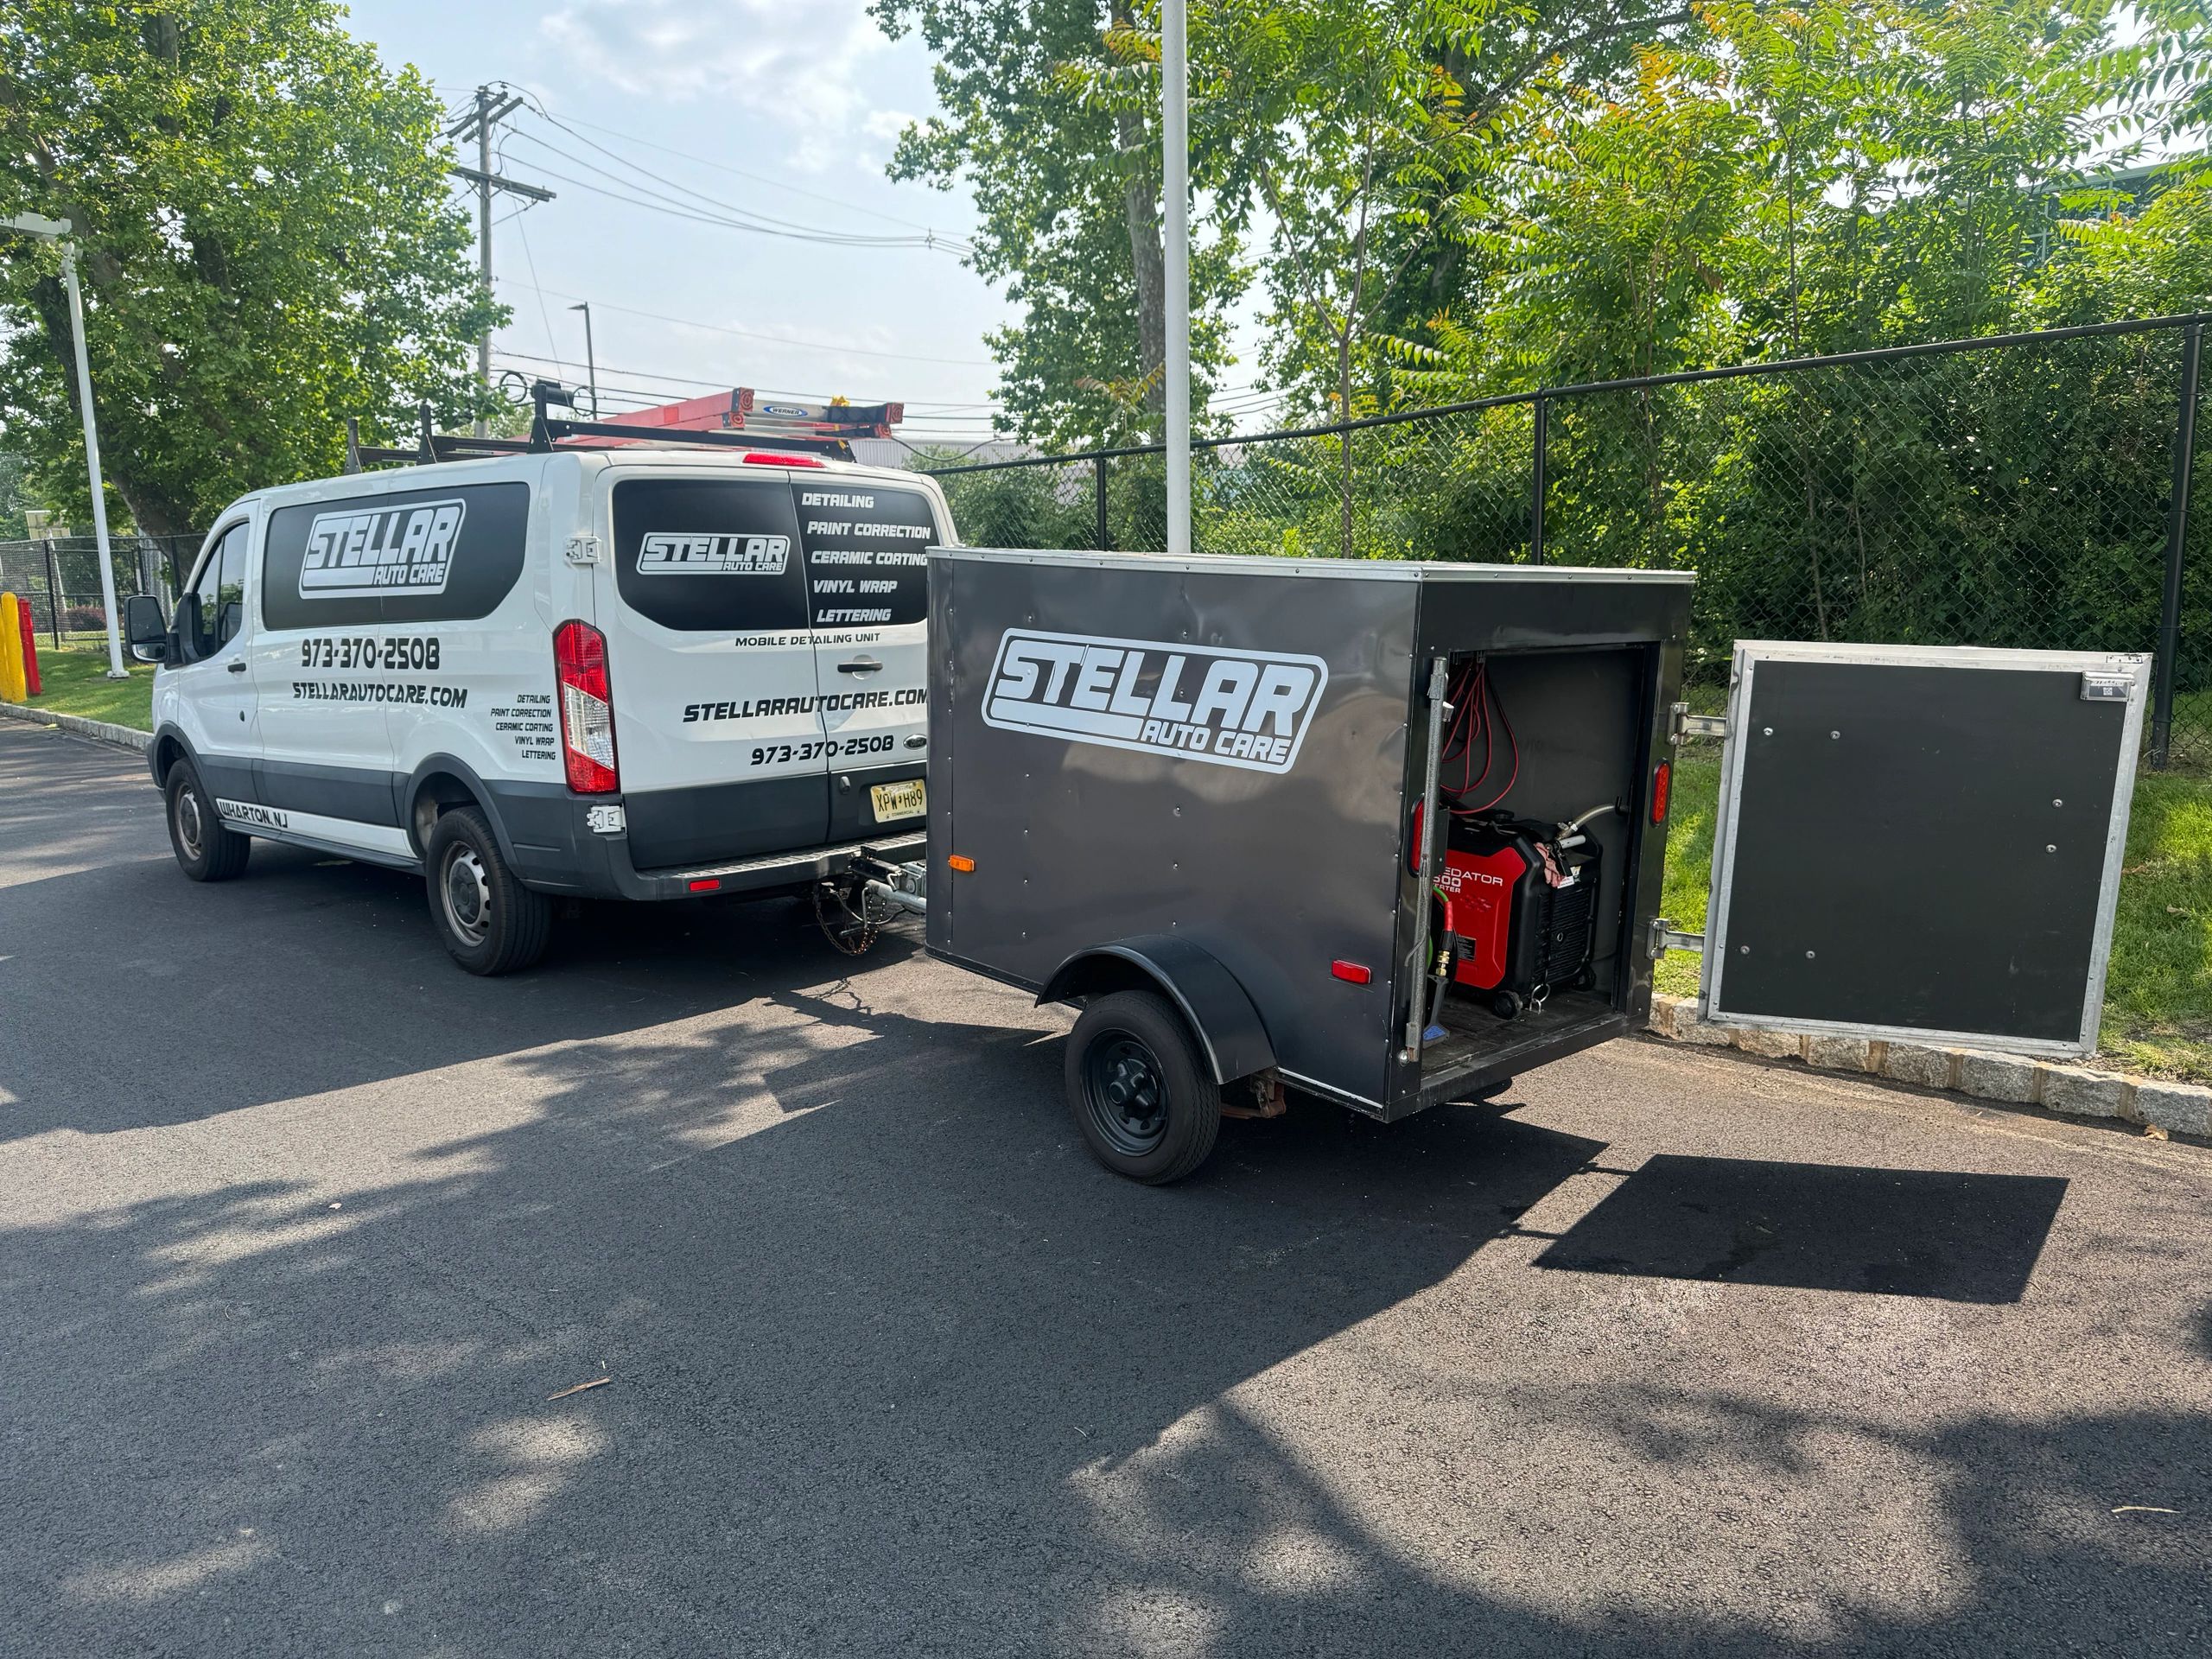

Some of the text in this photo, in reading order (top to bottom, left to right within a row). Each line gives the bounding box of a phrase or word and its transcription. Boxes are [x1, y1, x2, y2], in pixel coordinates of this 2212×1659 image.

[802, 493, 874, 508] DETAILING
[305, 506, 461, 569] STELLAR
[807, 521, 931, 539] PAINT CORRECTION
[643, 536, 787, 563] STELLAR
[810, 550, 927, 566] CERAMIC COATING
[373, 563, 446, 585] AUTO CARE
[722, 561, 783, 571] AUTO CARE
[813, 580, 898, 593] VINYL WRAP
[817, 608, 892, 622] LETTERING
[735, 632, 880, 646] MOBILE DETAILING UNIT
[302, 637, 440, 670] 973-370-2508
[292, 682, 467, 709] STELLARAUTOCARE.COM
[995, 639, 1315, 737] STELLAR
[517, 694, 550, 704] DETAILING
[683, 689, 928, 722] STELLARAUTOCARE.COM
[490, 708, 552, 718] PAINT CORRECTION
[495, 722, 554, 732] CERAMIC COATING
[514, 735, 555, 746] VINYL WRAP
[1141, 720, 1292, 764] AUTO CARE
[521, 749, 556, 760] LETTERING
[750, 735, 894, 766] 973-370-2508
[903, 788, 923, 808] H89
[273, 811, 289, 828] NJ
[1444, 867, 1503, 887] EDATOR
